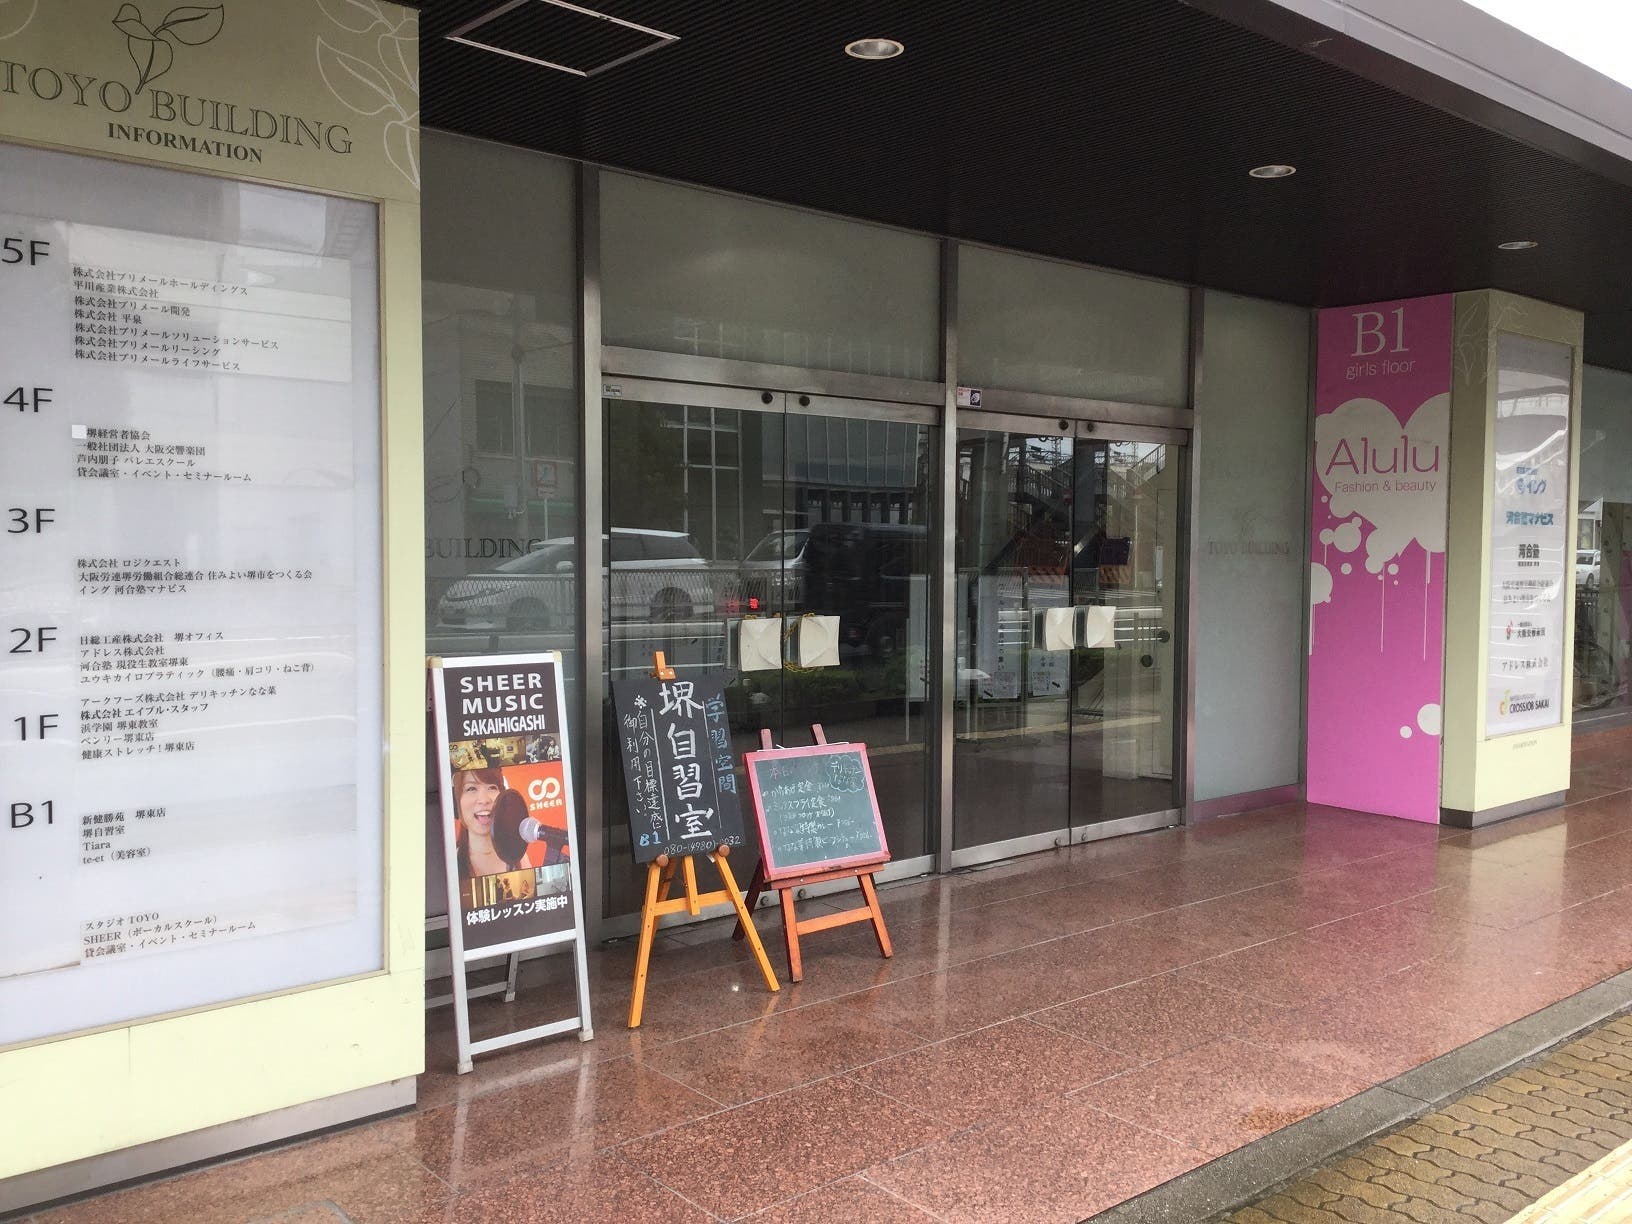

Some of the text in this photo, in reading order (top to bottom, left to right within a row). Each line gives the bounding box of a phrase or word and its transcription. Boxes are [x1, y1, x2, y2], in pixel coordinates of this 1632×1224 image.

[1, 59, 353, 155] TOYO BUILDING
[107, 122, 263, 164] INFORMATION
[2, 237, 50, 266] 5F
[74, 308, 117, 321] 株式会社
[1351, 307, 1410, 358] B1
[1345, 360, 1416, 381] girls floor
[4, 386, 54, 413] 4F
[86, 427, 151, 441] 堺経営者協会
[75, 441, 206, 457] 一般社団法人 大阪交響楽団
[1325, 434, 1440, 476] Alulu
[1334, 479, 1437, 494] Fashion & beauty
[8, 508, 56, 534] 3F
[77, 558, 181, 569] 株式会社 ロジクエスト
[208, 569, 313, 581] 住みよい堺市をつくる会
[79, 584, 188, 596] イング 河合塾マナビス
[9, 626, 58, 654] 2F
[174, 631, 224, 643] 堺オフィス
[80, 646, 165, 658] アドレス株式会社
[80, 660, 113, 672] 河合塾
[460, 672, 543, 694] SHEER
[80, 691, 186, 707] アークフーズ株式会社
[462, 693, 544, 715] MUSIC
[80, 708, 122, 721] 株式会社
[13, 713, 59, 742] 1F
[80, 718, 159, 734] 浜学園 堺東教室
[463, 714, 546, 737] SAKAIHIGASHI
[705, 693, 737, 795] 学習空間
[658, 680, 714, 840] 堺自習室
[10, 799, 56, 829] B1
[135, 807, 167, 820] 堺東店
[529, 798, 563, 812] SHEER
[82, 824, 126, 839] 堺自習室
[639, 830, 662, 848] B1
[83, 841, 111, 852] Tiara
[466, 893, 569, 926] 体験レッスン実施中
[85, 911, 160, 931] スタジオ TOYO
